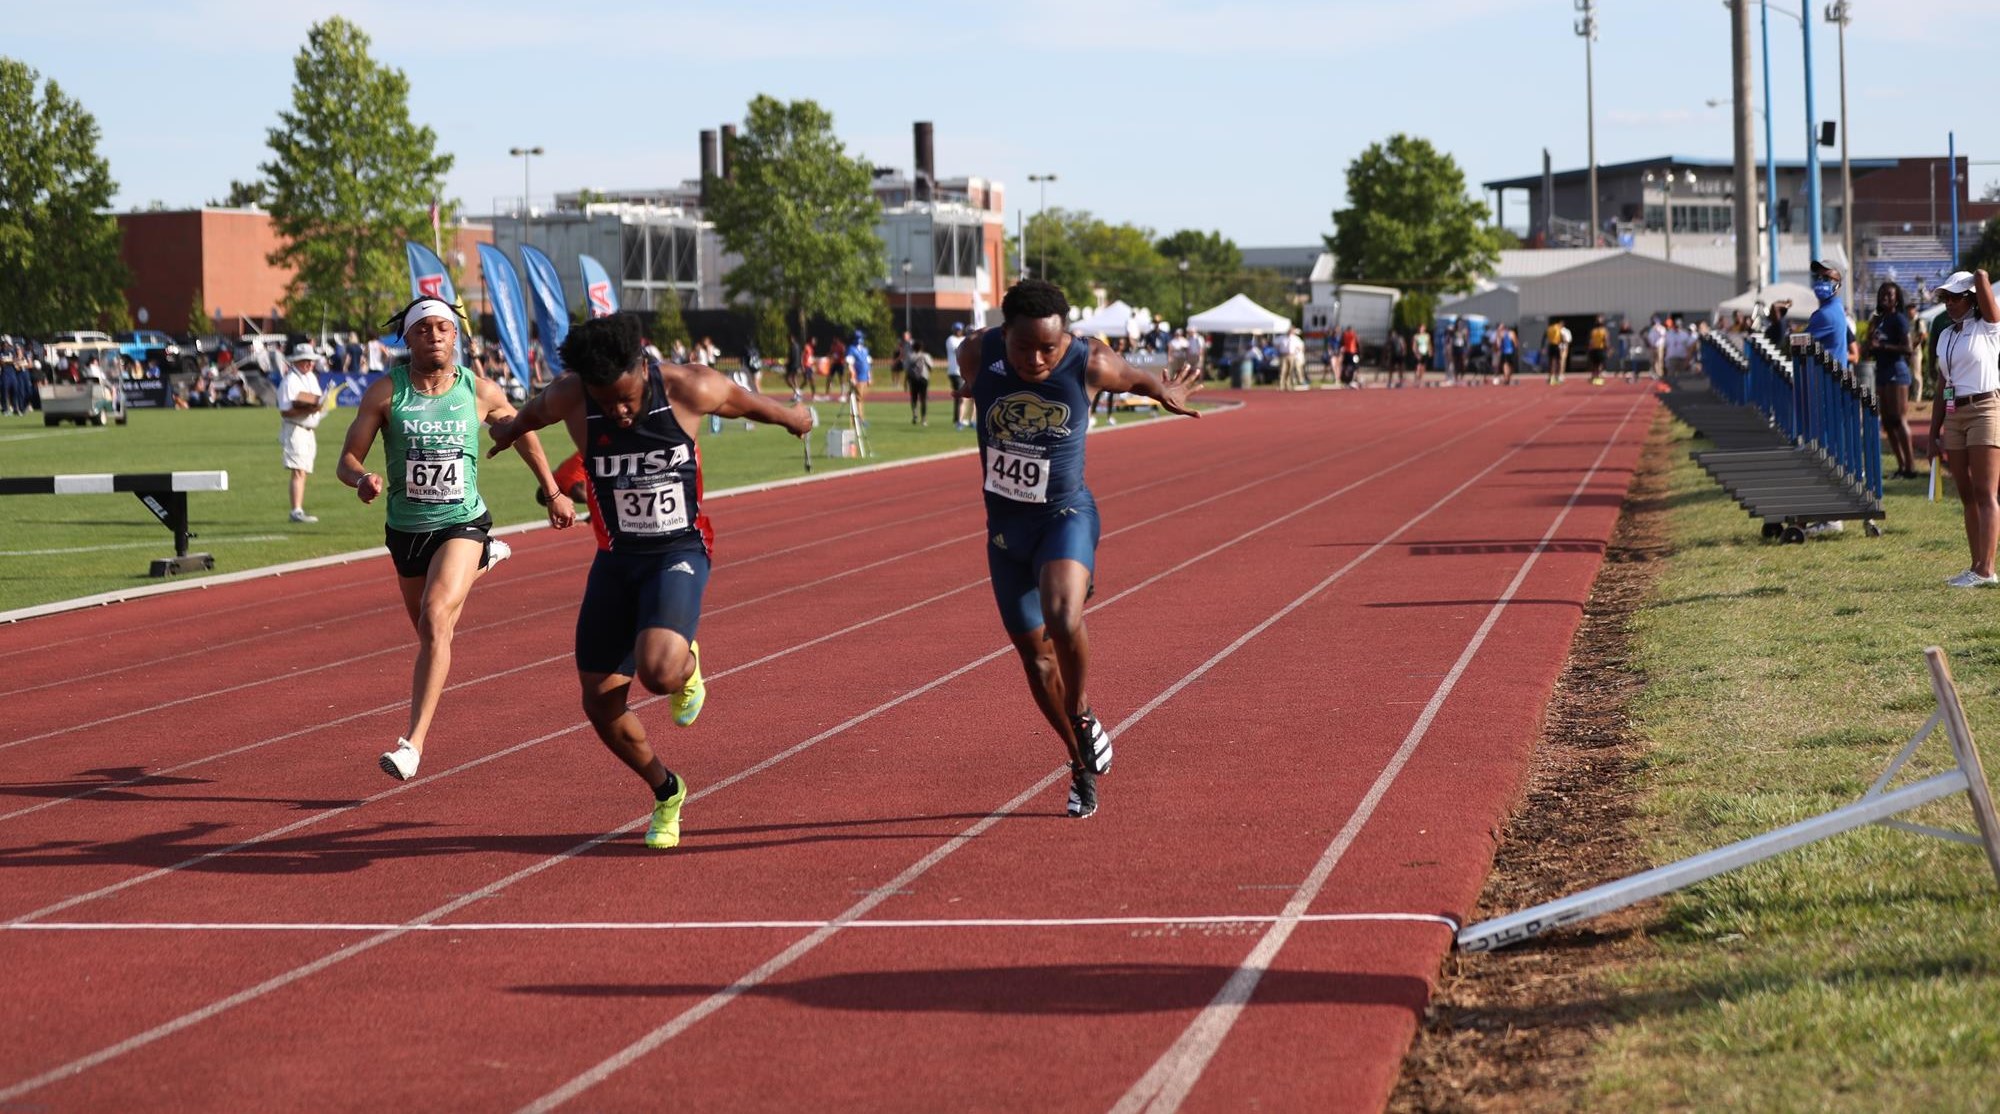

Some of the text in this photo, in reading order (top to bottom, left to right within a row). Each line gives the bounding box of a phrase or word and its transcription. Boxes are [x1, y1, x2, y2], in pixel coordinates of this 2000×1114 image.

[402, 419, 467, 434] NORTH
[407, 434, 465, 449] TEXAS
[593, 444, 690, 478] UTSA
[992, 455, 1040, 488] 449
[412, 463, 457, 487] 674
[623, 489, 676, 518] 375
[1013, 488, 1037, 500] Randy
